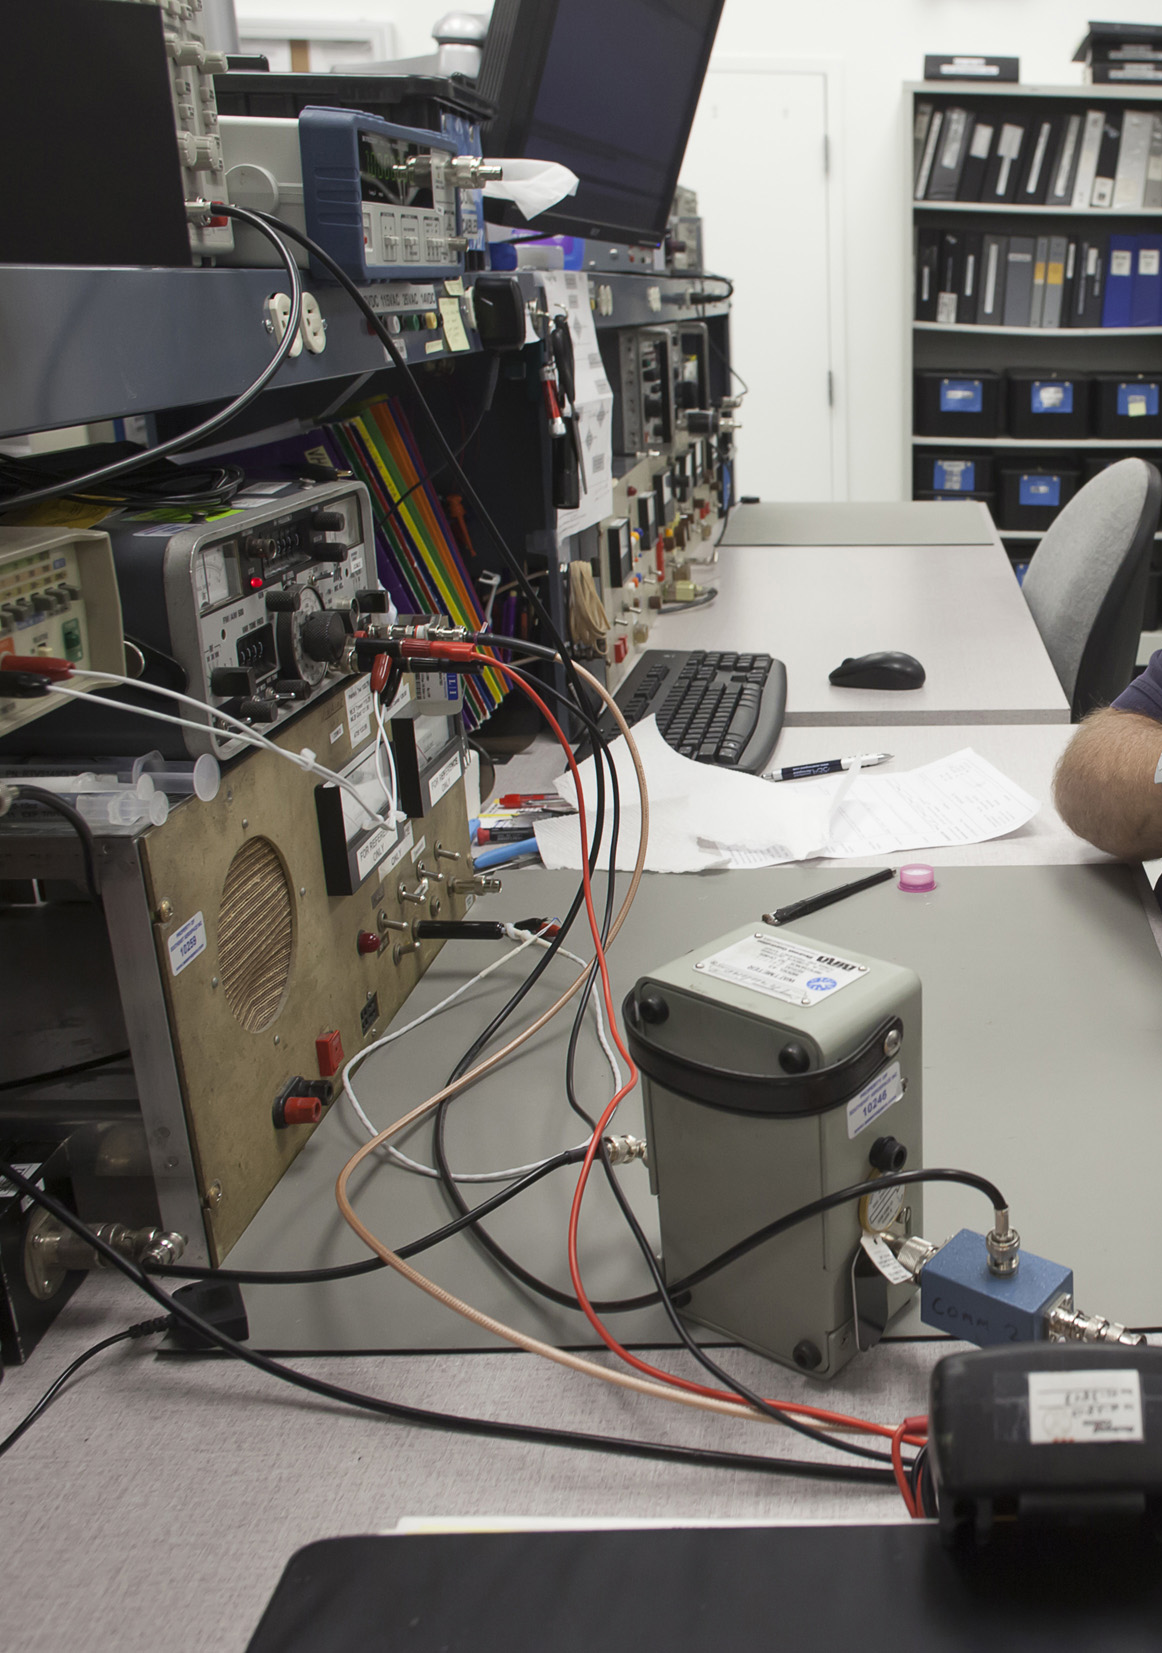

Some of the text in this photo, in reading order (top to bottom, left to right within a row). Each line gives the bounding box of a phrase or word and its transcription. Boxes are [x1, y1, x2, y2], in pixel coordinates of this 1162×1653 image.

[360, 846, 370, 862] FOR
[373, 844, 386, 862] ONLY
[863, 1089, 888, 1116] 10246
